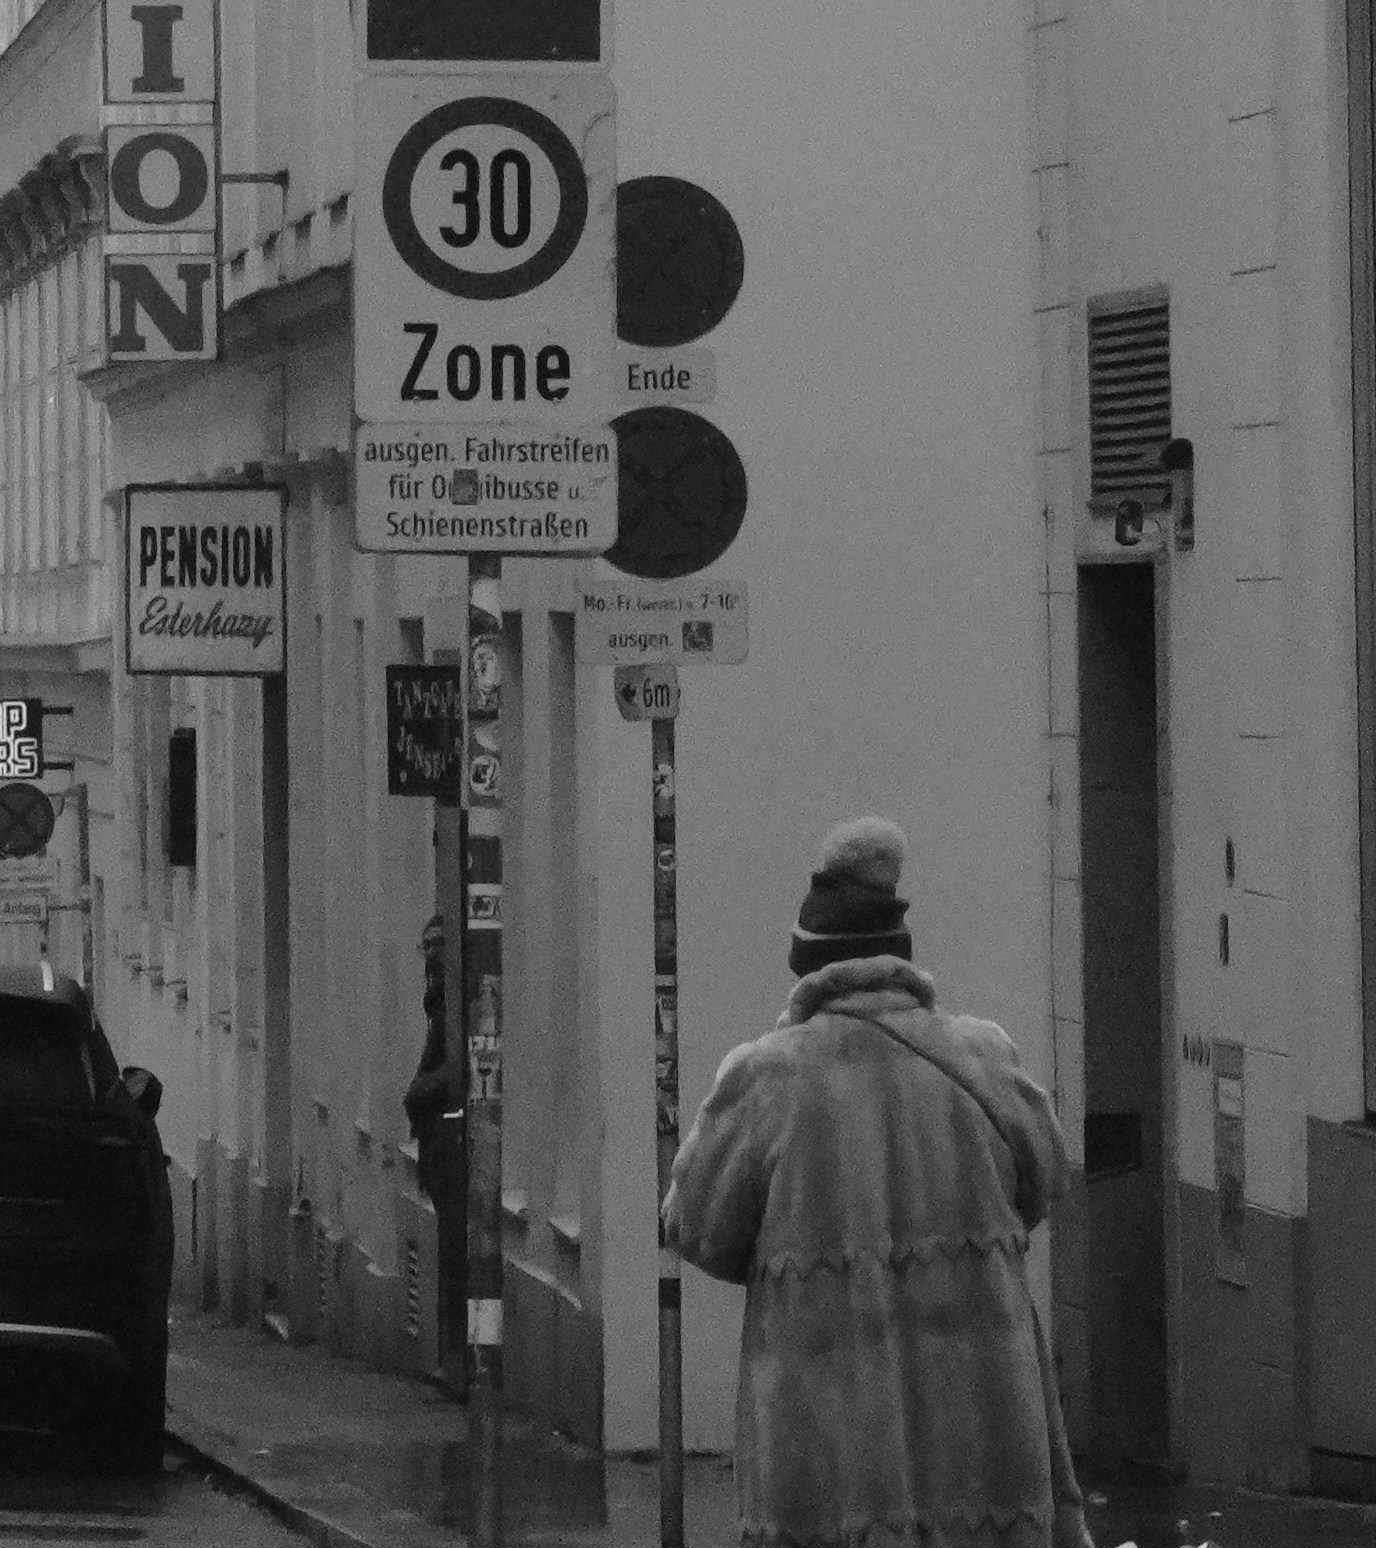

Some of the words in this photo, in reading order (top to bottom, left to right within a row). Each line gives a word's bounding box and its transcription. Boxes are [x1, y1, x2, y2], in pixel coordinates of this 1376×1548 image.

[438, 148, 532, 249] 30
[400, 322, 571, 401] Zone
[627, 362, 691, 391] Ende
[364, 441, 455, 467] ausgen.
[464, 437, 610, 464] Fahrstreifen
[388, 473, 423, 500] für
[432, 474, 560, 501] Oibusse
[386, 510, 589, 539] Schienenstraßen
[139, 524, 274, 589] PENSION
[138, 595, 275, 649] Esterhazy
[641, 678, 671, 709] 6m
